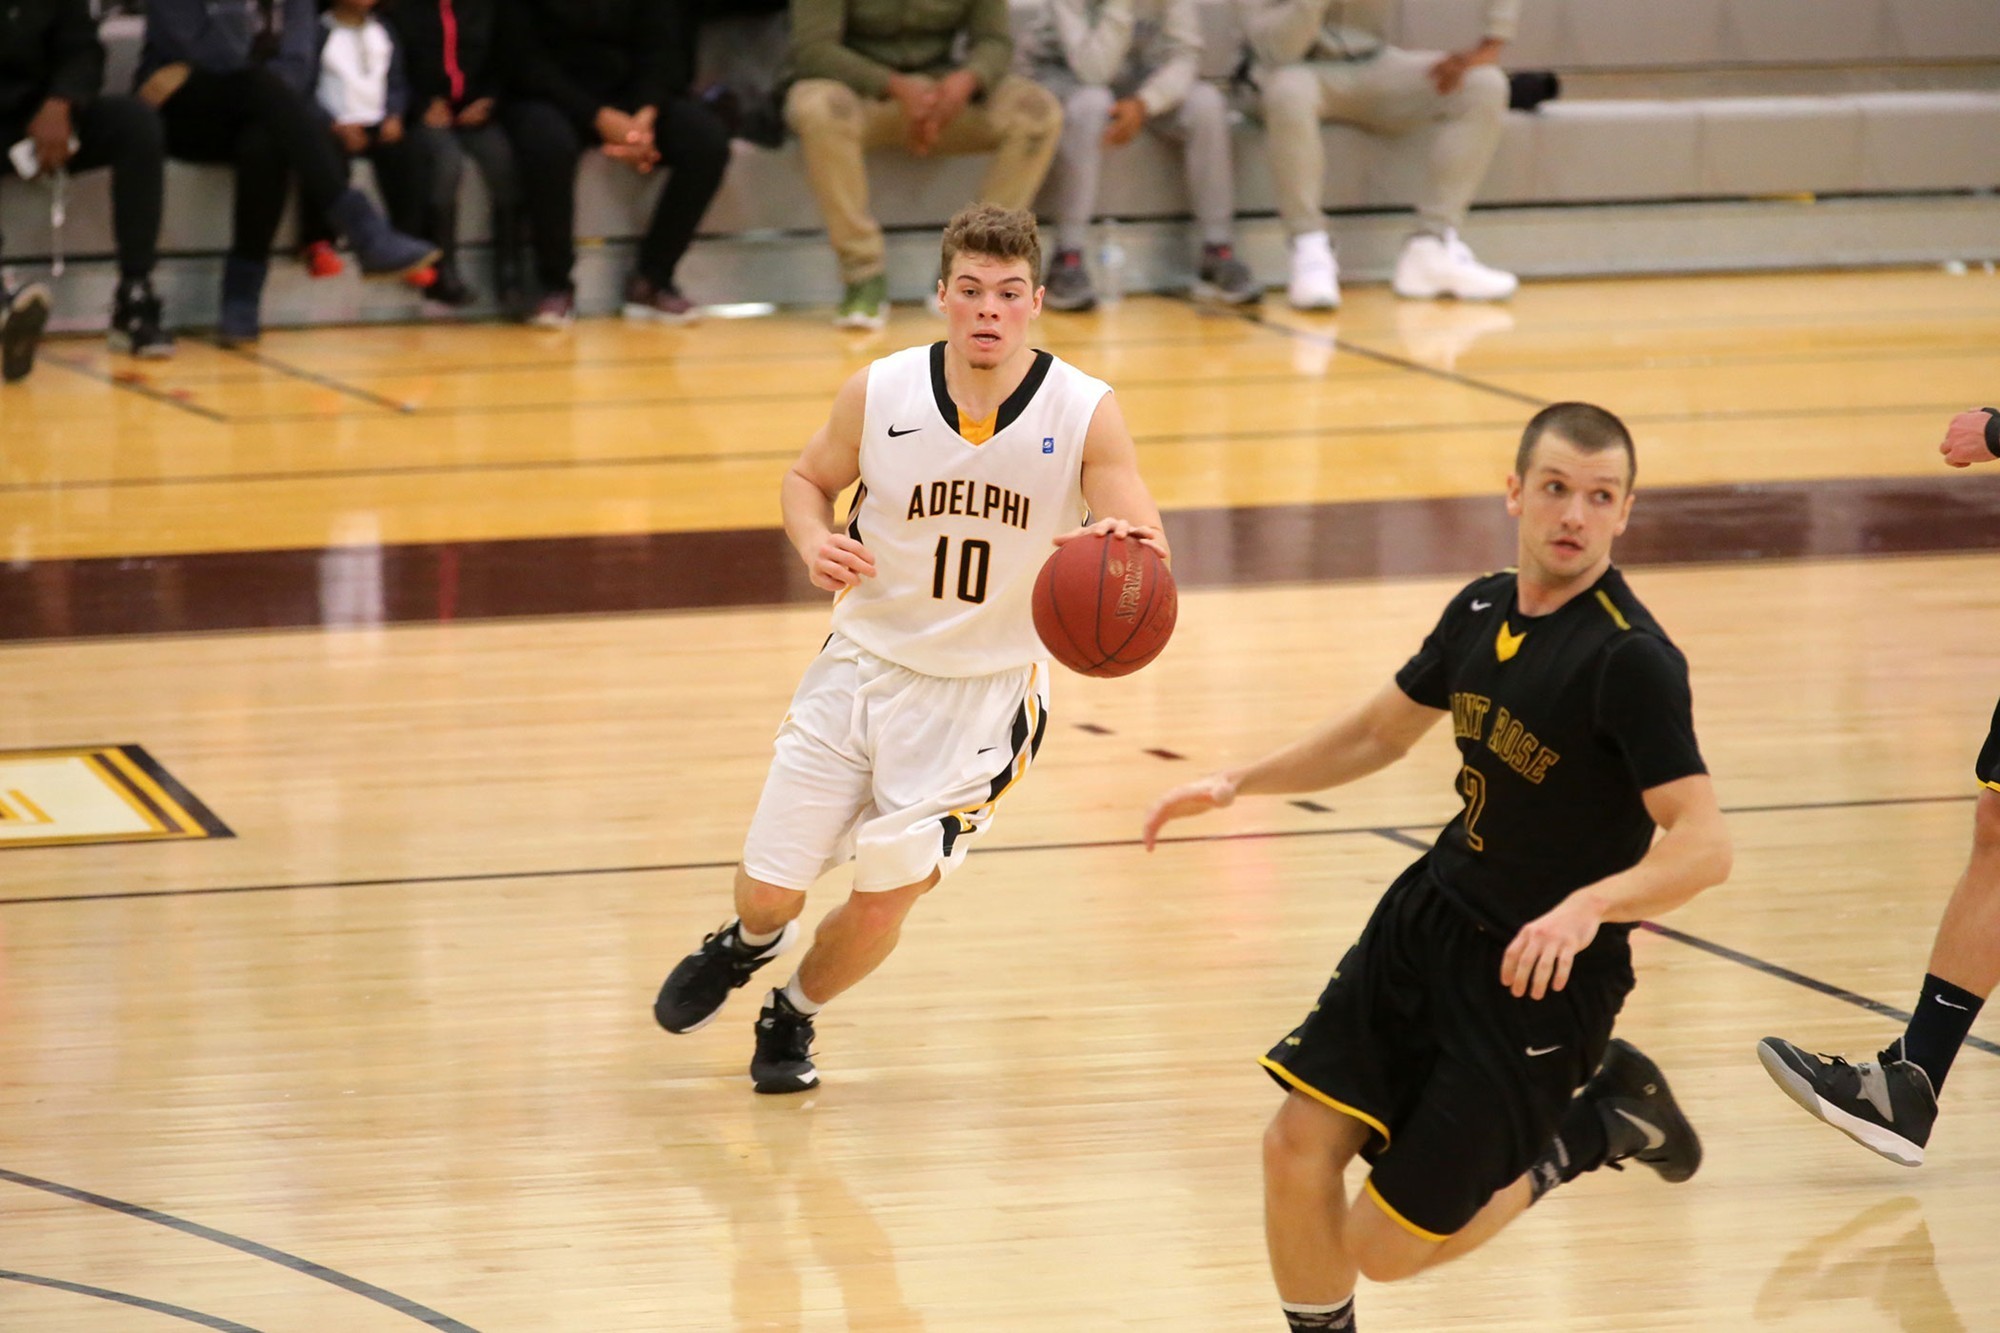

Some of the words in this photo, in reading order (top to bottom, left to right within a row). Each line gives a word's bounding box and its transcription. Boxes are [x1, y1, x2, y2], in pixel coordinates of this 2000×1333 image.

[907, 480, 1030, 530] ADELPHI
[932, 535, 991, 604] 10
[1114, 547, 1144, 625] SPALD
[1451, 692, 1491, 740] INT
[1488, 707, 1560, 784] ROSE
[1463, 765, 1486, 851] 2
